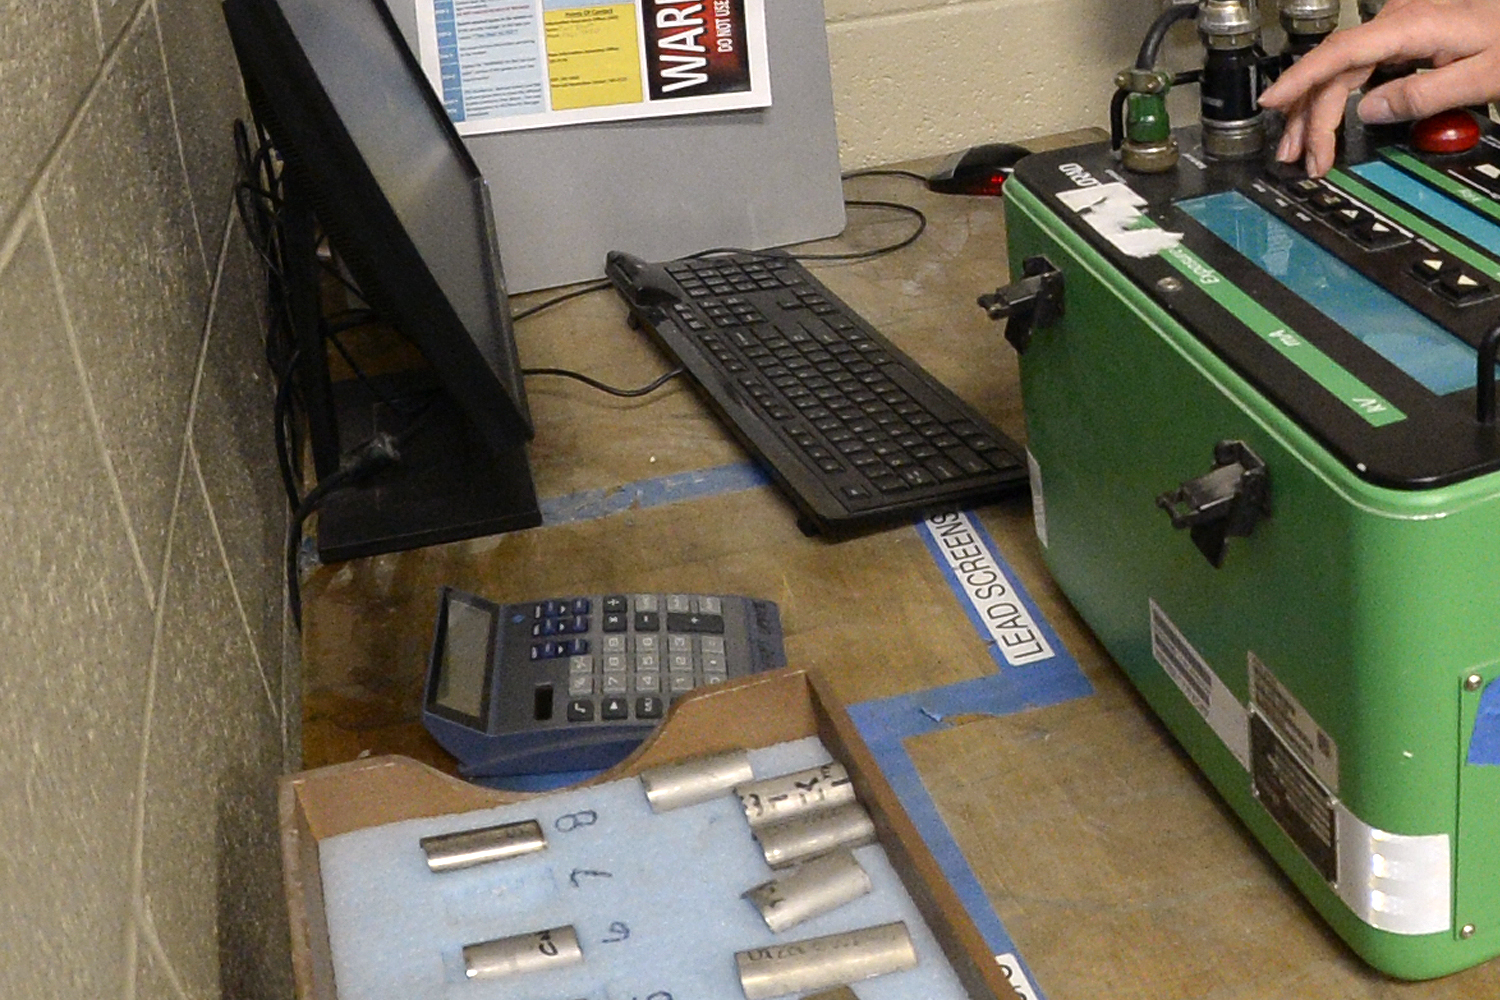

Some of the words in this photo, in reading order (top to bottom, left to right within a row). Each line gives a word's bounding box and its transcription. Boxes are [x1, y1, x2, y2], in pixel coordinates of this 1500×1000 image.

[714, 0, 730, 17] USE
[715, 18, 732, 37] NOT
[717, 38, 733, 53] DO
[930, 511, 1006, 600] SCREENS
[987, 602, 1043, 659] LEAD
[555, 809, 599, 833] 8
